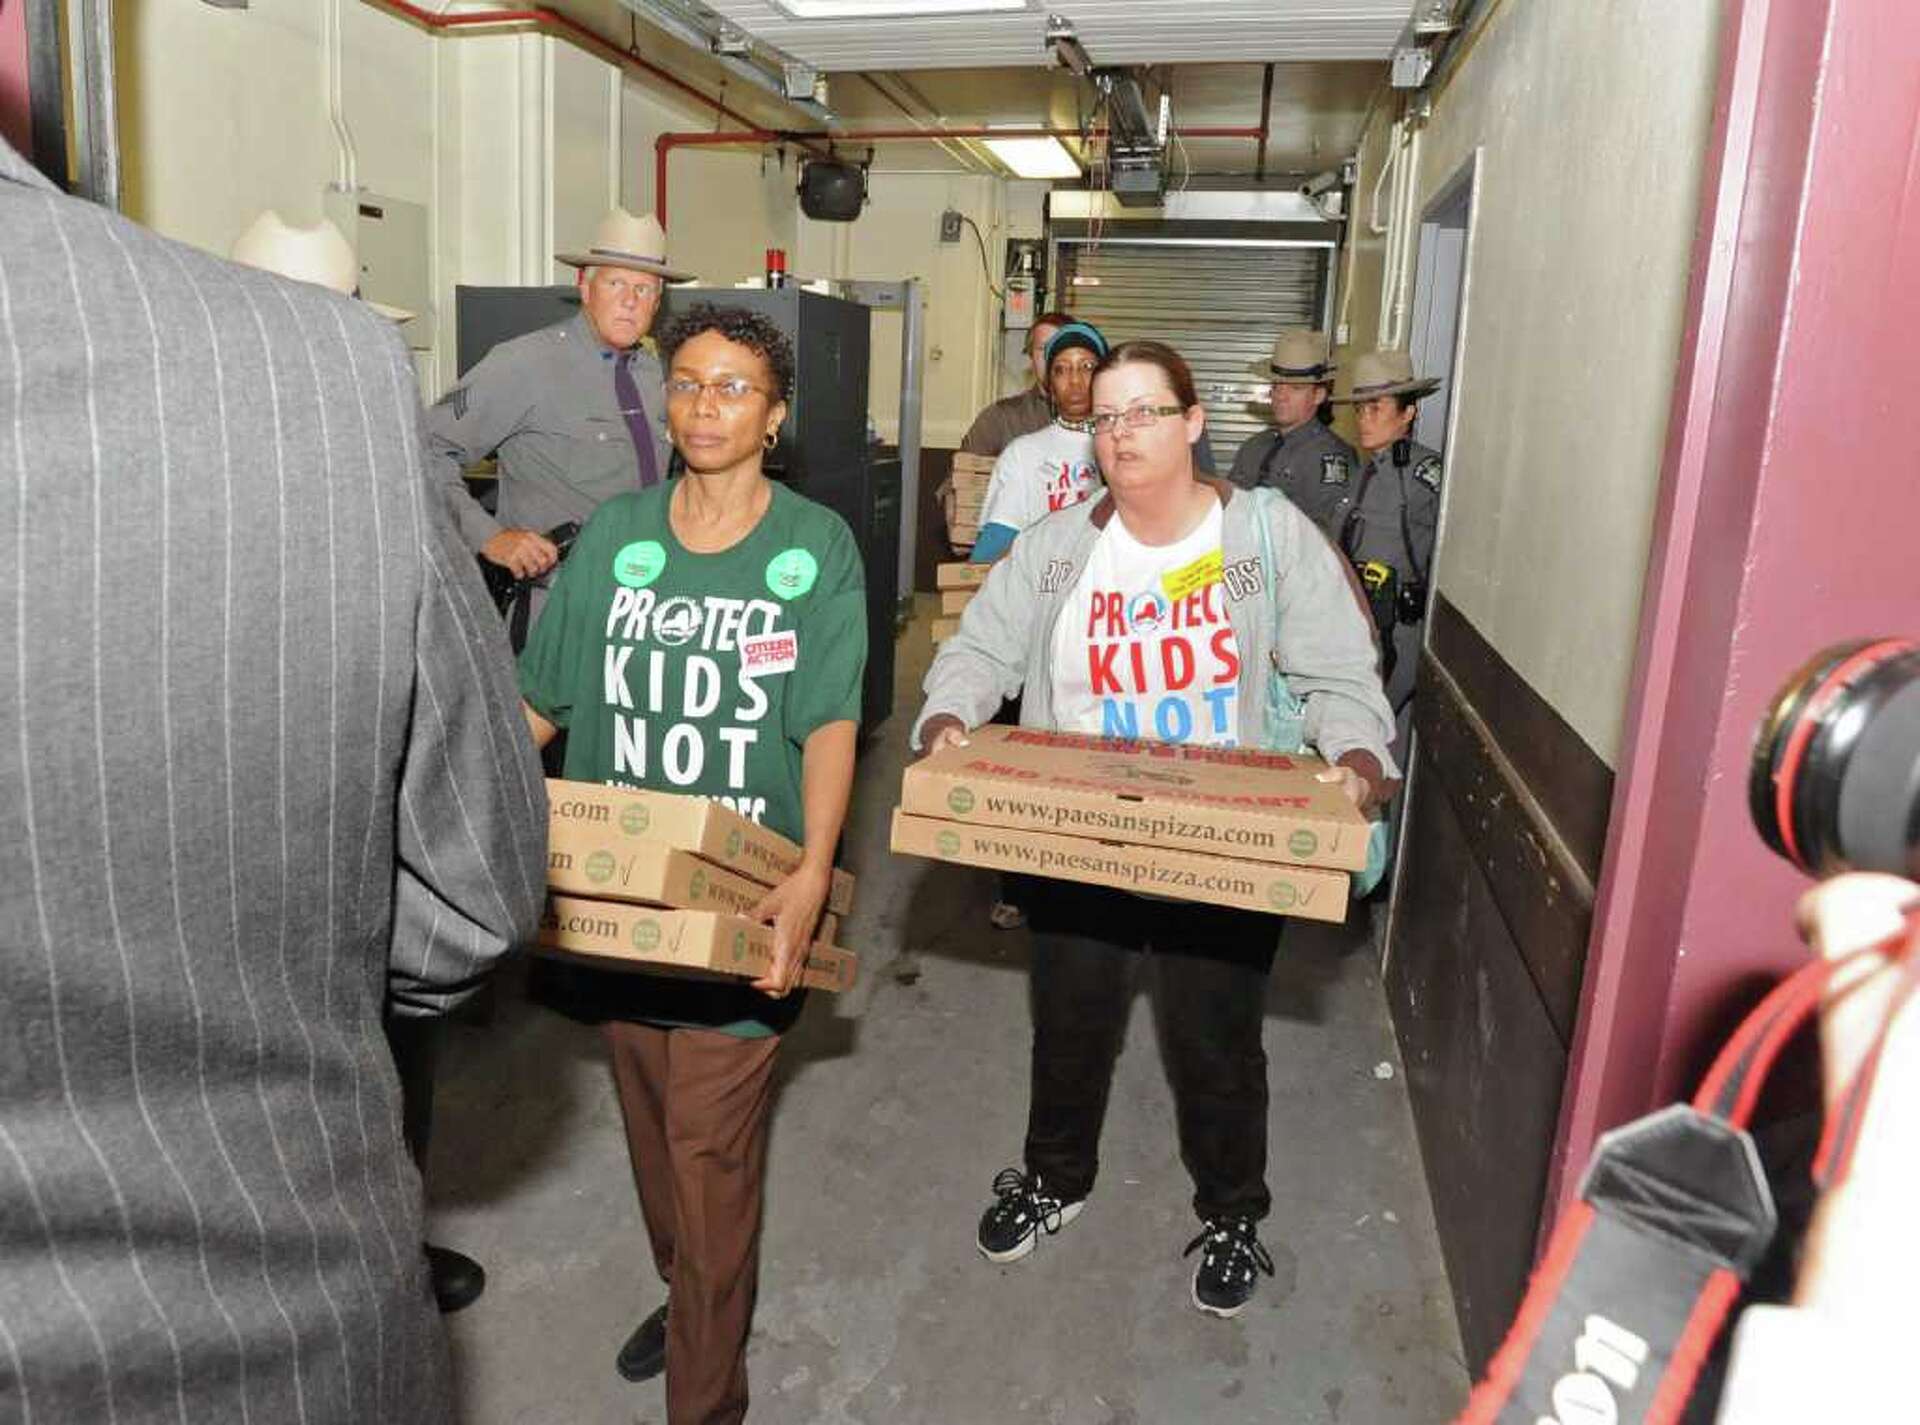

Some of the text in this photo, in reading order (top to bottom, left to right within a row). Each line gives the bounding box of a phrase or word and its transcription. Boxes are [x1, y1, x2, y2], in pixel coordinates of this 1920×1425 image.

[1087, 583, 1232, 638] PROTEC
[604, 645, 769, 721] KIDS
[1088, 628, 1240, 695] KIDS
[1103, 687, 1236, 743] NOT
[614, 713, 758, 789] NOT
[986, 796, 1275, 848] www.paesanspizza.com
[974, 839, 1256, 896] www.paesanspizza.com
